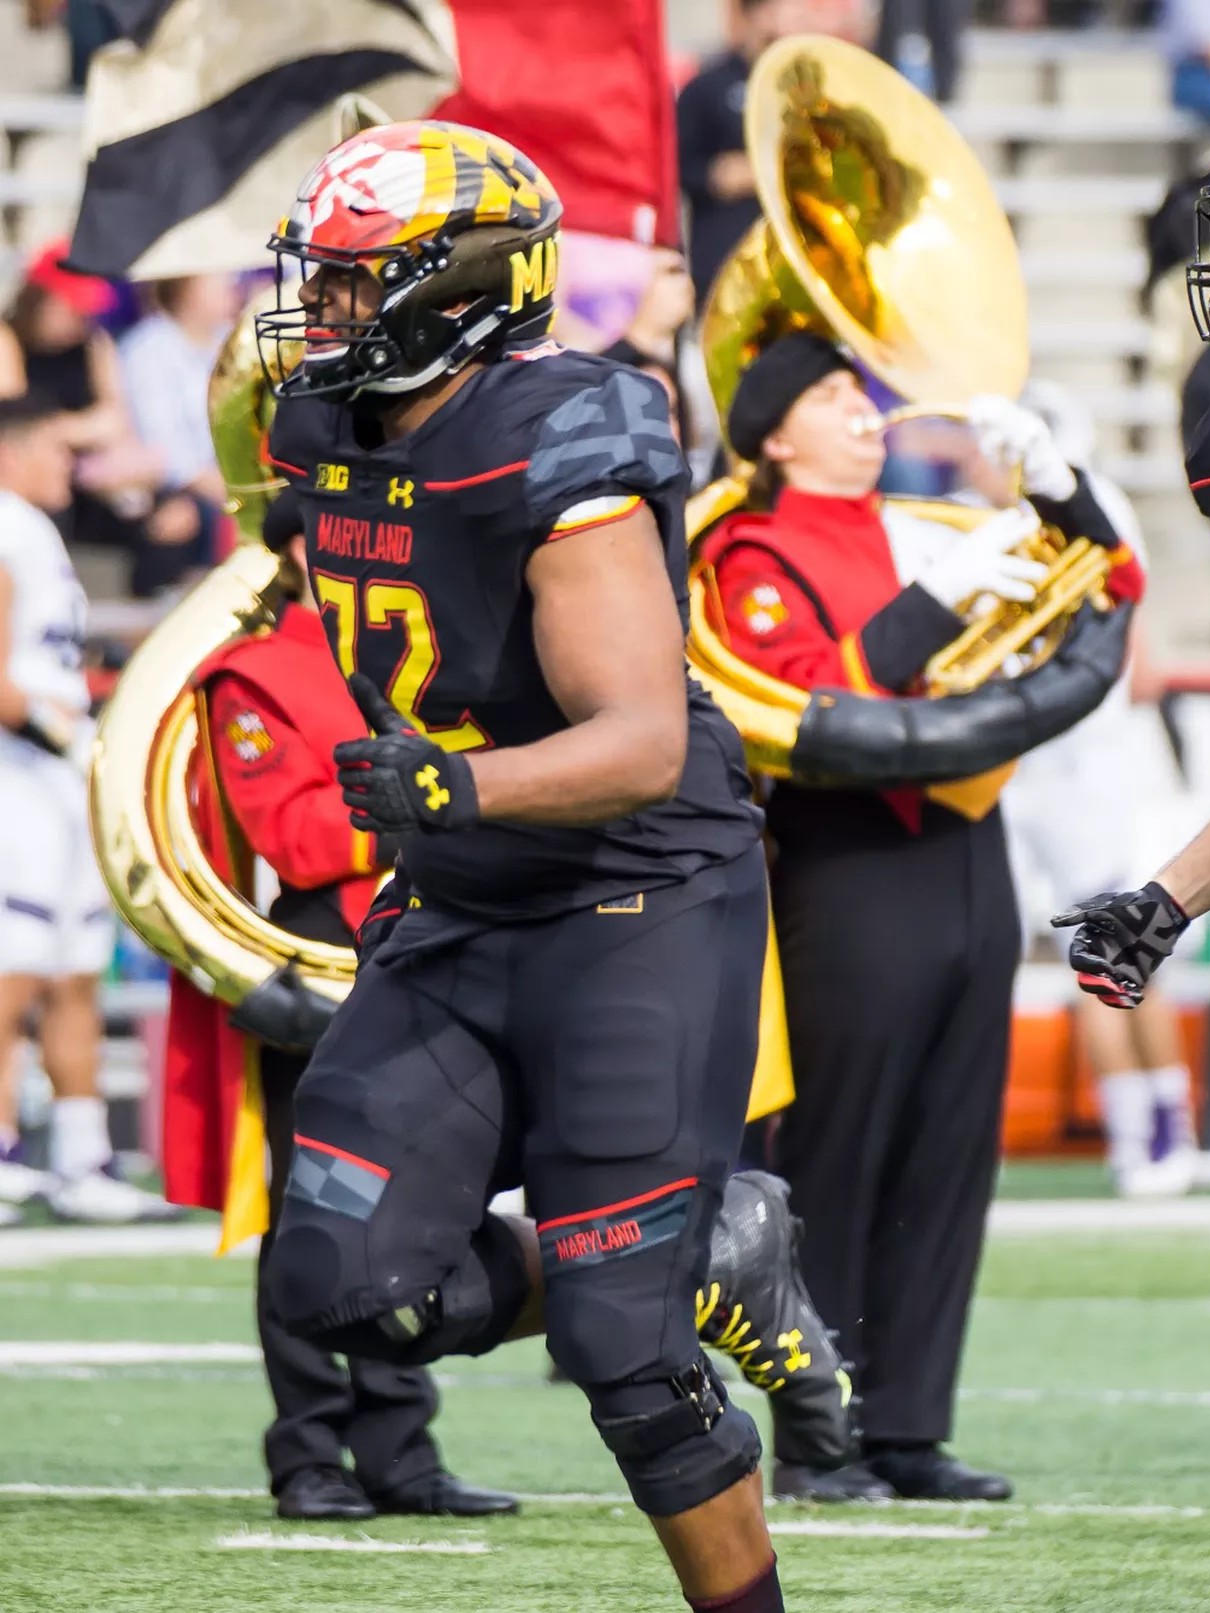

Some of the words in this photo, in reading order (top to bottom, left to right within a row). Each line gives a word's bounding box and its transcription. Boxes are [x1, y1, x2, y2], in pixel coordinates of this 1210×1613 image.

[317, 512, 413, 565] MARYLAND
[313, 567, 496, 754] 72
[555, 1219, 642, 1262] MARYLAND
